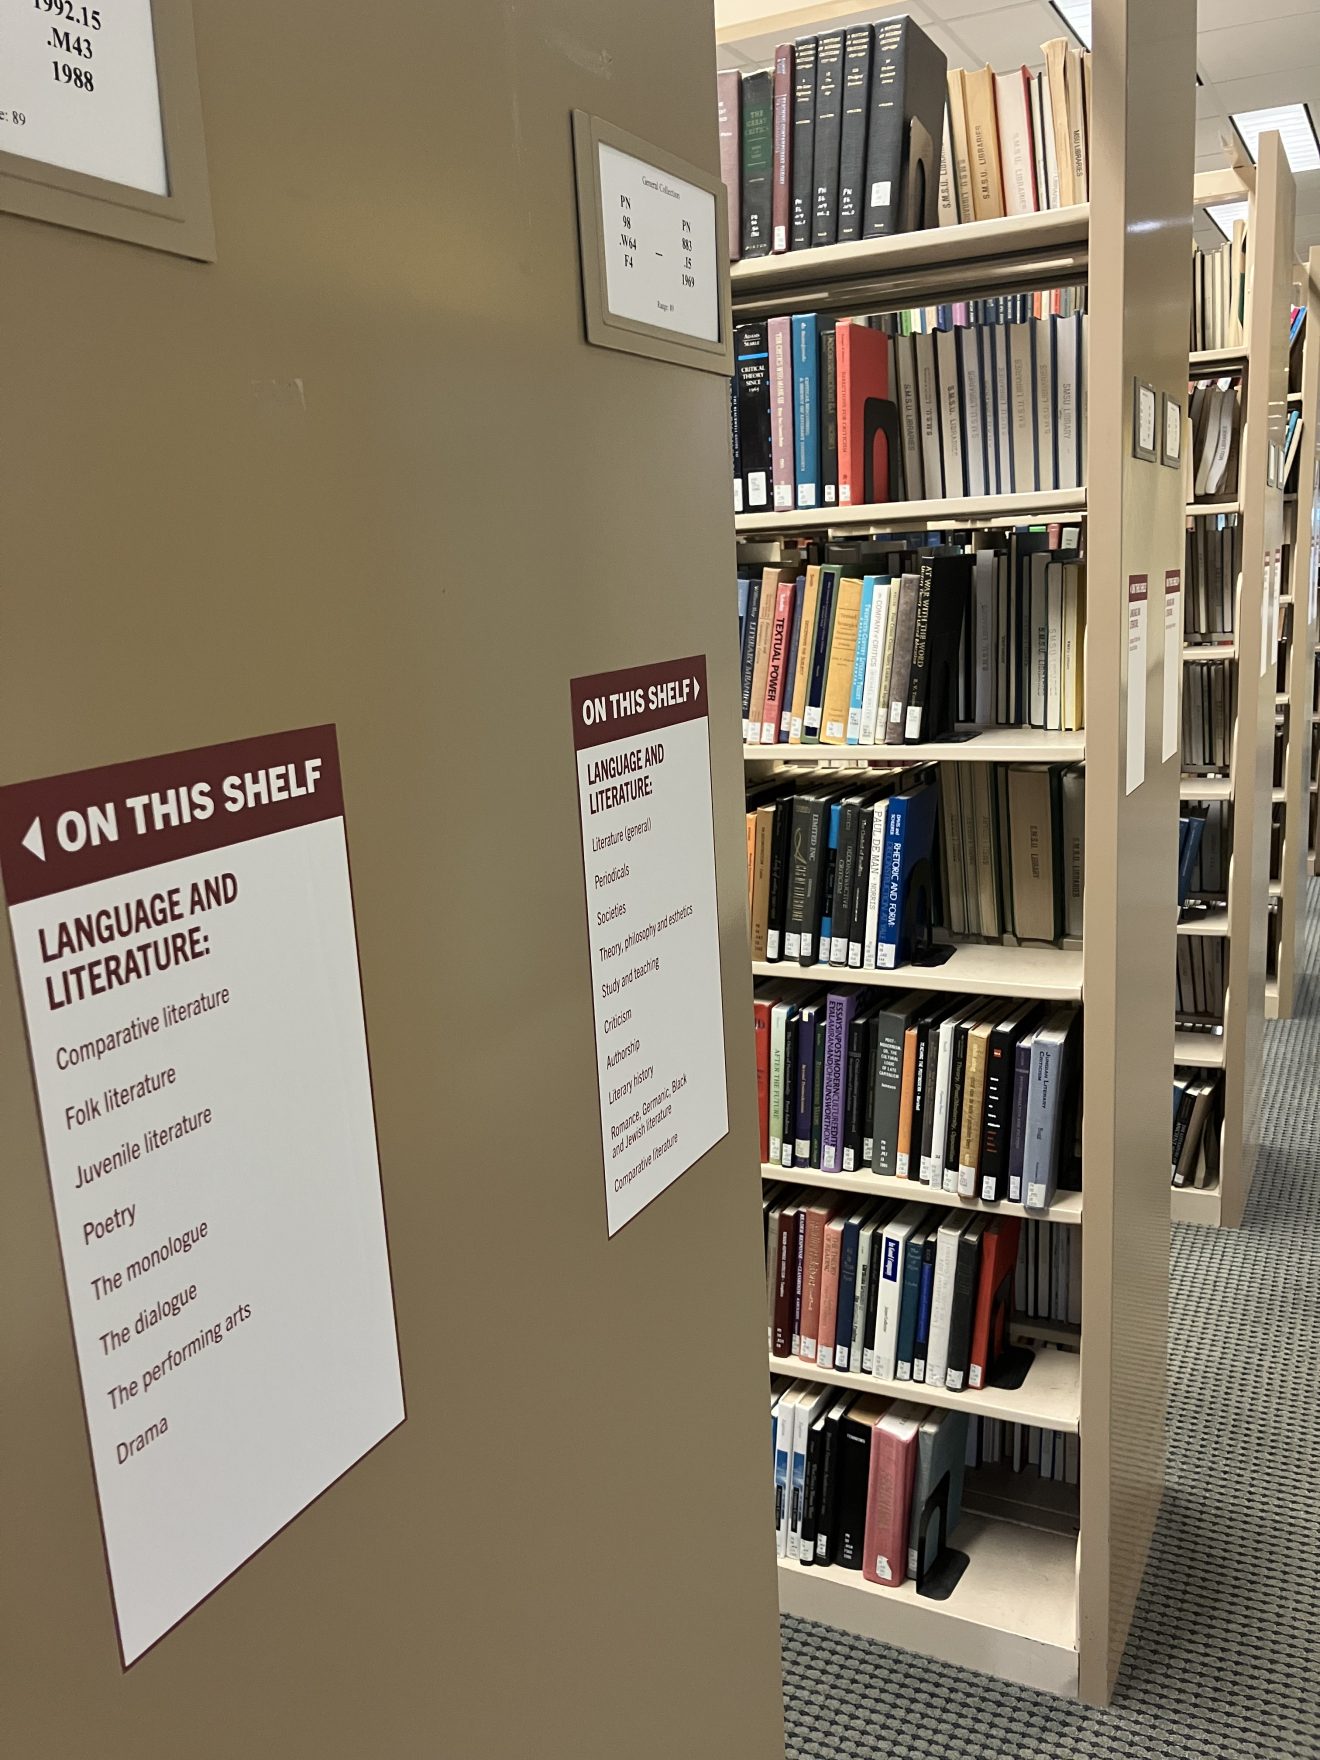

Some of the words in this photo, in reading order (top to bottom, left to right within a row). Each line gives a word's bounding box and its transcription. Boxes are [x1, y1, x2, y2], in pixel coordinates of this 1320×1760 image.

[47, 27, 93, 59] .M43
[52, 61, 94, 92] 1988
[12, 111, 26, 126] 89
[973, 125, 986, 165] LIBRARIES
[1073, 145, 1083, 176] LIBRARIES
[620, 195, 631, 210] PN
[642, 176, 659, 191] General
[659, 181, 680, 200] Collection
[622, 216, 631, 229] 98
[682, 219, 691, 233] PN
[619, 234, 637, 251] .W64
[682, 237, 692, 252] 883
[624, 254, 633, 268] F4
[681, 273, 695, 288] 1969
[743, 372, 764, 380] THEORY
[1063, 408, 1071, 439] LIBRARY
[924, 565, 932, 576] AT
[923, 578, 931, 597] WAR
[872, 600, 882, 633] COMPANY
[921, 599, 929, 621] WITH
[745, 621, 756, 663] LITERARY
[771, 617, 784, 662] TEXTUAL
[919, 623, 927, 640] THE
[870, 639, 879, 666] CRITICS
[917, 641, 925, 667] WORD
[741, 665, 752, 709] MEANING
[767, 664, 778, 701] POWER
[583, 698, 607, 725] ON
[610, 688, 645, 719] THIS
[649, 678, 690, 710] SHELF
[587, 749, 642, 785] LANGUAGE
[644, 743, 664, 766] AND
[57, 803, 118, 852] ON
[126, 782, 214, 834] THIS
[223, 758, 322, 812] SHELF
[589, 775, 653, 815] LITERATURE:
[592, 829, 624, 852] Literature
[624, 817, 652, 842] (general)
[809, 813, 819, 845] LIMITED
[872, 810, 882, 836] PAUL
[808, 847, 816, 861] INC
[871, 838, 880, 852] DE
[890, 842, 901, 879] RHETORIC
[594, 863, 630, 889] Periodicals
[842, 845, 852, 908] DECONSTRUCTIVE
[870, 854, 879, 874] MAN
[881, 841, 893, 909] DECONSTRUCTION
[868, 883, 876, 910] NORRIS
[889, 881, 898, 900] AND
[39, 888, 183, 963] LANGUAGE
[190, 872, 238, 915] AND
[597, 902, 626, 926] Societies
[887, 903, 896, 927] FORM:
[600, 941, 624, 962] Theory,
[624, 921, 657, 951] philosophy
[657, 915, 668, 932] and
[668, 904, 693, 926] esthetics
[46, 926, 211, 1011] LITERATURE:
[601, 979, 621, 998] Study
[621, 969, 633, 985] and
[634, 956, 660, 980] teaching
[57, 1016, 160, 1071] Comparative
[163, 988, 230, 1028] literature
[604, 1008, 632, 1035] Criticism
[606, 1039, 641, 1070] Authorship
[65, 1097, 102, 1130] Folk
[104, 1066, 176, 1112] literature
[608, 1078, 633, 1105] Literary
[633, 1064, 654, 1086] history
[610, 1110, 641, 1140] Romance,
[642, 1088, 671, 1116] Germanic,
[671, 1073, 687, 1094] Black
[75, 1142, 141, 1188] Juvenile
[144, 1106, 212, 1152] literature
[612, 1142, 624, 1159] and
[625, 1124, 646, 1150] Jewish
[646, 1104, 672, 1134] literature
[614, 1155, 652, 1193] Comparative
[652, 1132, 678, 1161] literature
[83, 1204, 136, 1245] Poetry
[91, 1270, 122, 1300] The
[127, 1221, 208, 1281] monologue
[99, 1326, 131, 1356] The
[135, 1283, 197, 1335] dialogue
[107, 1379, 139, 1410] The
[143, 1322, 223, 1393] performing
[225, 1302, 251, 1332] arts
[116, 1416, 168, 1465] Drama
